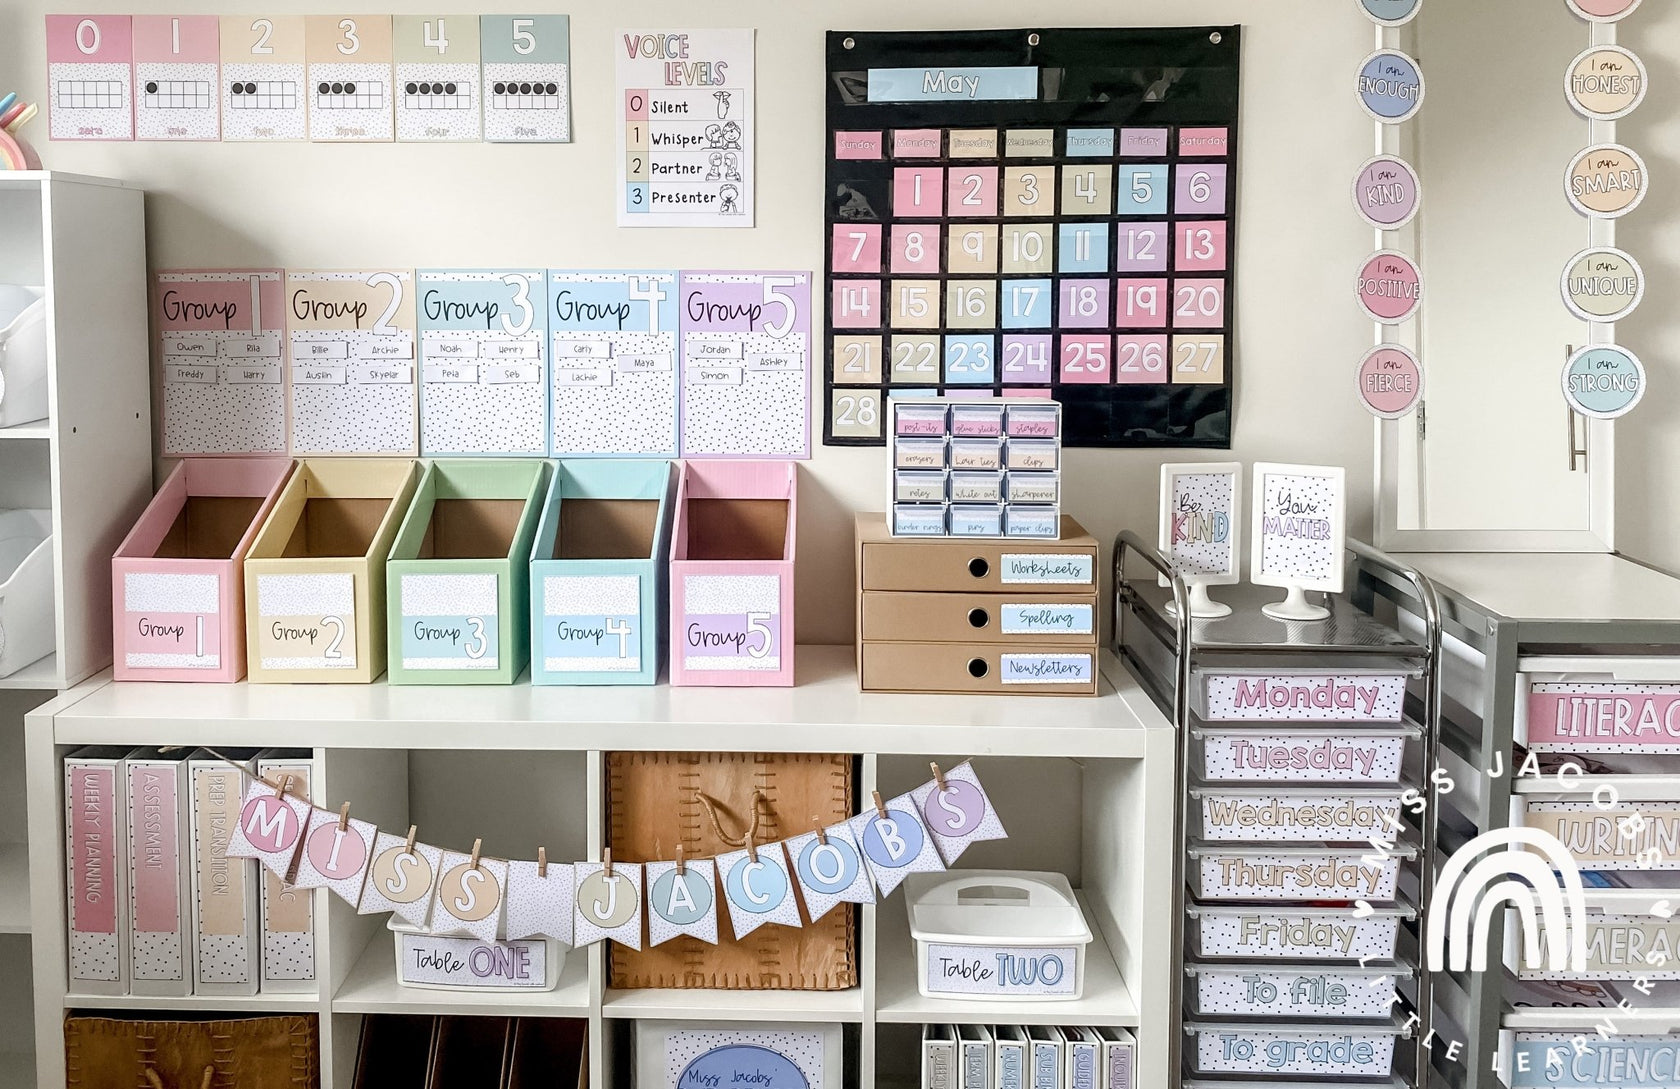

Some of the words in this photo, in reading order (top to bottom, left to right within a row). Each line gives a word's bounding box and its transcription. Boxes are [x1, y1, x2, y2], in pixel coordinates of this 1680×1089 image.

[75, 19, 102, 55] 0
[171, 18, 180, 54] 1
[250, 19, 274, 55] 2
[336, 19, 360, 55] 3
[423, 19, 450, 54] 4
[512, 19, 537, 55] 5
[624, 34, 689, 59] VOICE
[664, 61, 728, 86] LEVELS
[1385, 65, 1405, 77] am
[1600, 62, 1622, 72] am
[921, 70, 981, 97] May
[1357, 76, 1420, 102] ENOUGH
[1571, 74, 1640, 95] HONEST
[630, 95, 643, 112] 0
[651, 99, 689, 114] Silent
[633, 126, 640, 143] 1
[651, 132, 704, 150] Whisper
[840, 139, 877, 152] Sunday
[896, 137, 938, 149] Monday
[952, 137, 995, 149] Tuesday
[1006, 137, 1054, 149] Wednesday
[1067, 135, 1114, 148] Thursday
[1127, 135, 1160, 148] Friday
[1179, 135, 1227, 147] Saturday
[632, 158, 642, 174] 2
[651, 162, 703, 175] Partner
[1378, 171, 1397, 182] am
[1597, 159, 1619, 169] am
[914, 174, 921, 205] 1
[961, 175, 983, 205] 2
[1017, 174, 1040, 205] 3
[1074, 172, 1097, 203] 4
[1131, 171, 1153, 203] 5
[1188, 171, 1211, 203] 6
[1571, 168, 1641, 197] SMART
[632, 188, 643, 205] 3
[652, 190, 717, 204] Presenter
[1365, 183, 1405, 208] KIND
[848, 232, 867, 262] 7
[904, 232, 925, 262] 8
[962, 231, 984, 262] 9
[1013, 231, 1044, 261] 10
[1075, 230, 1090, 261] 11
[1127, 229, 1156, 260] 12
[1185, 228, 1214, 260] 13
[1384, 263, 1404, 275] am
[1595, 262, 1618, 271] am
[1357, 277, 1420, 301] POSITIVE
[1568, 276, 1637, 296] UNIQUE
[163, 290, 237, 330] Group
[249, 275, 262, 337] 1
[293, 289, 368, 330] Group
[366, 272, 403, 336] 2
[424, 289, 499, 330] Group
[500, 273, 534, 337] 3
[556, 290, 631, 331] Group
[628, 275, 667, 337] 4
[687, 290, 762, 332] Group
[762, 276, 798, 340] 5
[841, 286, 870, 318] 14
[900, 286, 928, 318] 15
[956, 286, 986, 318] 16
[1012, 286, 1041, 318] 17
[1069, 286, 1099, 317] 18
[1126, 285, 1157, 316] 19
[1176, 285, 1221, 317] 20
[177, 343, 205, 352] Owen
[371, 346, 400, 355] Archie
[440, 344, 462, 353] Noah
[498, 345, 524, 355] Henry
[700, 344, 731, 354] Jordan
[842, 343, 871, 373] 21
[895, 342, 936, 373] 22
[949, 342, 990, 373] 23
[1005, 342, 1047, 373] 24
[1064, 342, 1106, 373] 25
[1119, 342, 1162, 373] 26
[1176, 342, 1218, 373] 27
[178, 369, 205, 380] Freddy
[504, 369, 520, 379] Seb
[634, 358, 655, 368] Maya
[759, 357, 788, 367] Ashley
[1383, 360, 1403, 371] am
[1596, 360, 1619, 370] am
[243, 370, 266, 381] Harry
[571, 372, 598, 382] Lachie
[700, 371, 730, 380] Simon
[1365, 373, 1412, 393] FIERCE
[1568, 373, 1639, 394] STRONG
[836, 396, 876, 426] 28
[904, 421, 938, 434] post-its
[1015, 423, 1049, 434] staples
[1023, 456, 1044, 467] clips
[1011, 487, 1055, 500] sharpener
[1180, 492, 1202, 512] Be
[1277, 490, 1318, 515] You
[1010, 523, 1030, 533] paper
[1171, 511, 1230, 545] KIND
[1263, 515, 1331, 541] MATTER
[1011, 560, 1082, 577] Worksheets
[1019, 609, 1074, 628] Spelling
[138, 617, 184, 647] Group
[195, 615, 204, 657] 1
[271, 621, 318, 646] Group
[319, 615, 346, 659] 2
[414, 621, 461, 646] Group
[463, 615, 488, 660] 3
[557, 621, 604, 646] Group
[605, 617, 632, 659] 4
[687, 622, 746, 654] Group
[746, 611, 773, 659] 5
[1009, 659, 1082, 676] Newsletters
[1233, 678, 1379, 715] Monday
[1555, 697, 1680, 738] LITERAC
[1230, 740, 1377, 776] Tuesday
[83, 773, 101, 827] WEEKLY
[208, 775, 225, 807] PREP
[143, 772, 162, 870] ASSESSMENT
[1208, 799, 1396, 833] Wednesday
[209, 811, 229, 896] TRANSITION
[84, 833, 102, 904] PLANNING
[1217, 858, 1381, 894] Thursday
[1240, 917, 1356, 953] Friday
[413, 948, 465, 974] Table
[468, 946, 530, 979] ONE
[939, 957, 994, 982] Table
[995, 953, 1064, 986] TWO
[1243, 976, 1277, 1004] To
[1289, 977, 1347, 1005] file
[1219, 1034, 1254, 1061] To
[1266, 1035, 1374, 1068] grade
[688, 1069, 721, 1087] Miss
